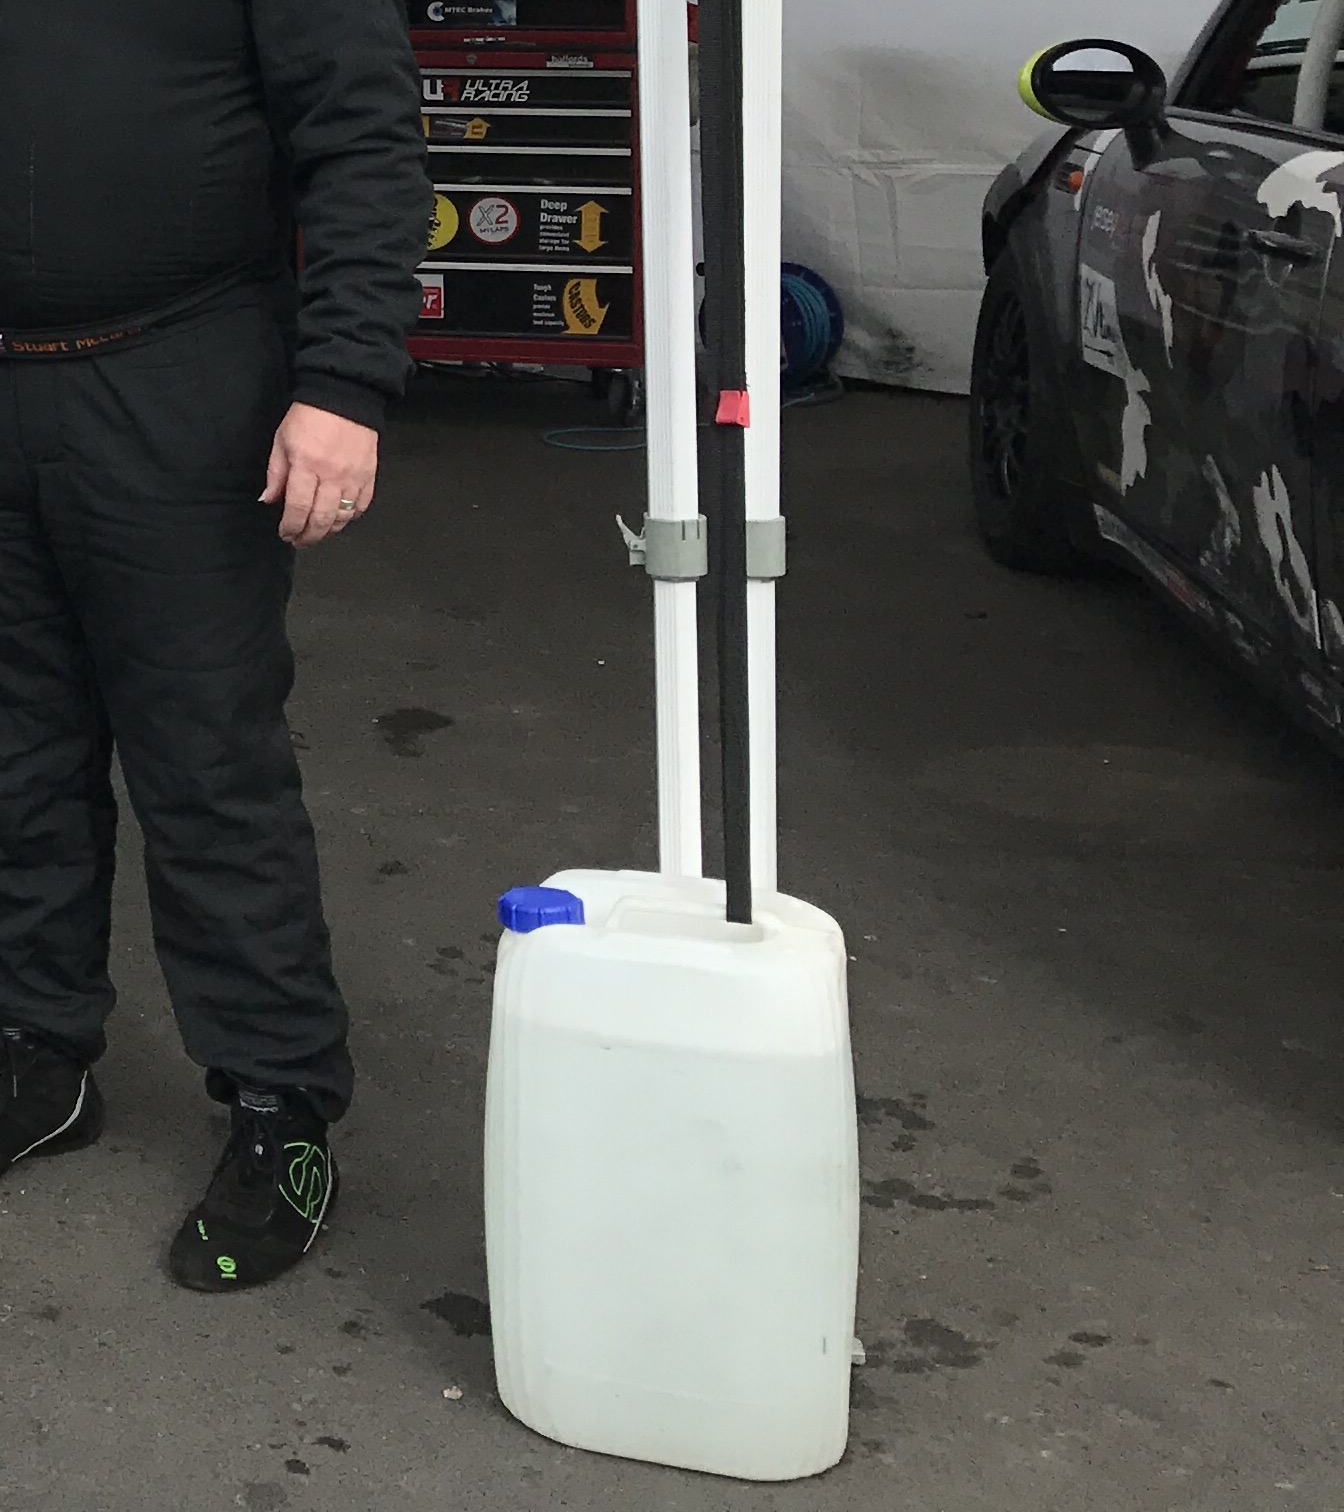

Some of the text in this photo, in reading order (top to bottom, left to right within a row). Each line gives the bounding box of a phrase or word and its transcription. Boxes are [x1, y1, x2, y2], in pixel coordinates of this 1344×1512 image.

[465, 79, 529, 91] ULTRA
[461, 90, 530, 102] RACING
[540, 199, 567, 212] Deep
[476, 204, 509, 227] X2
[540, 213, 578, 224] Drawer
[13, 340, 69, 353] Stuart
